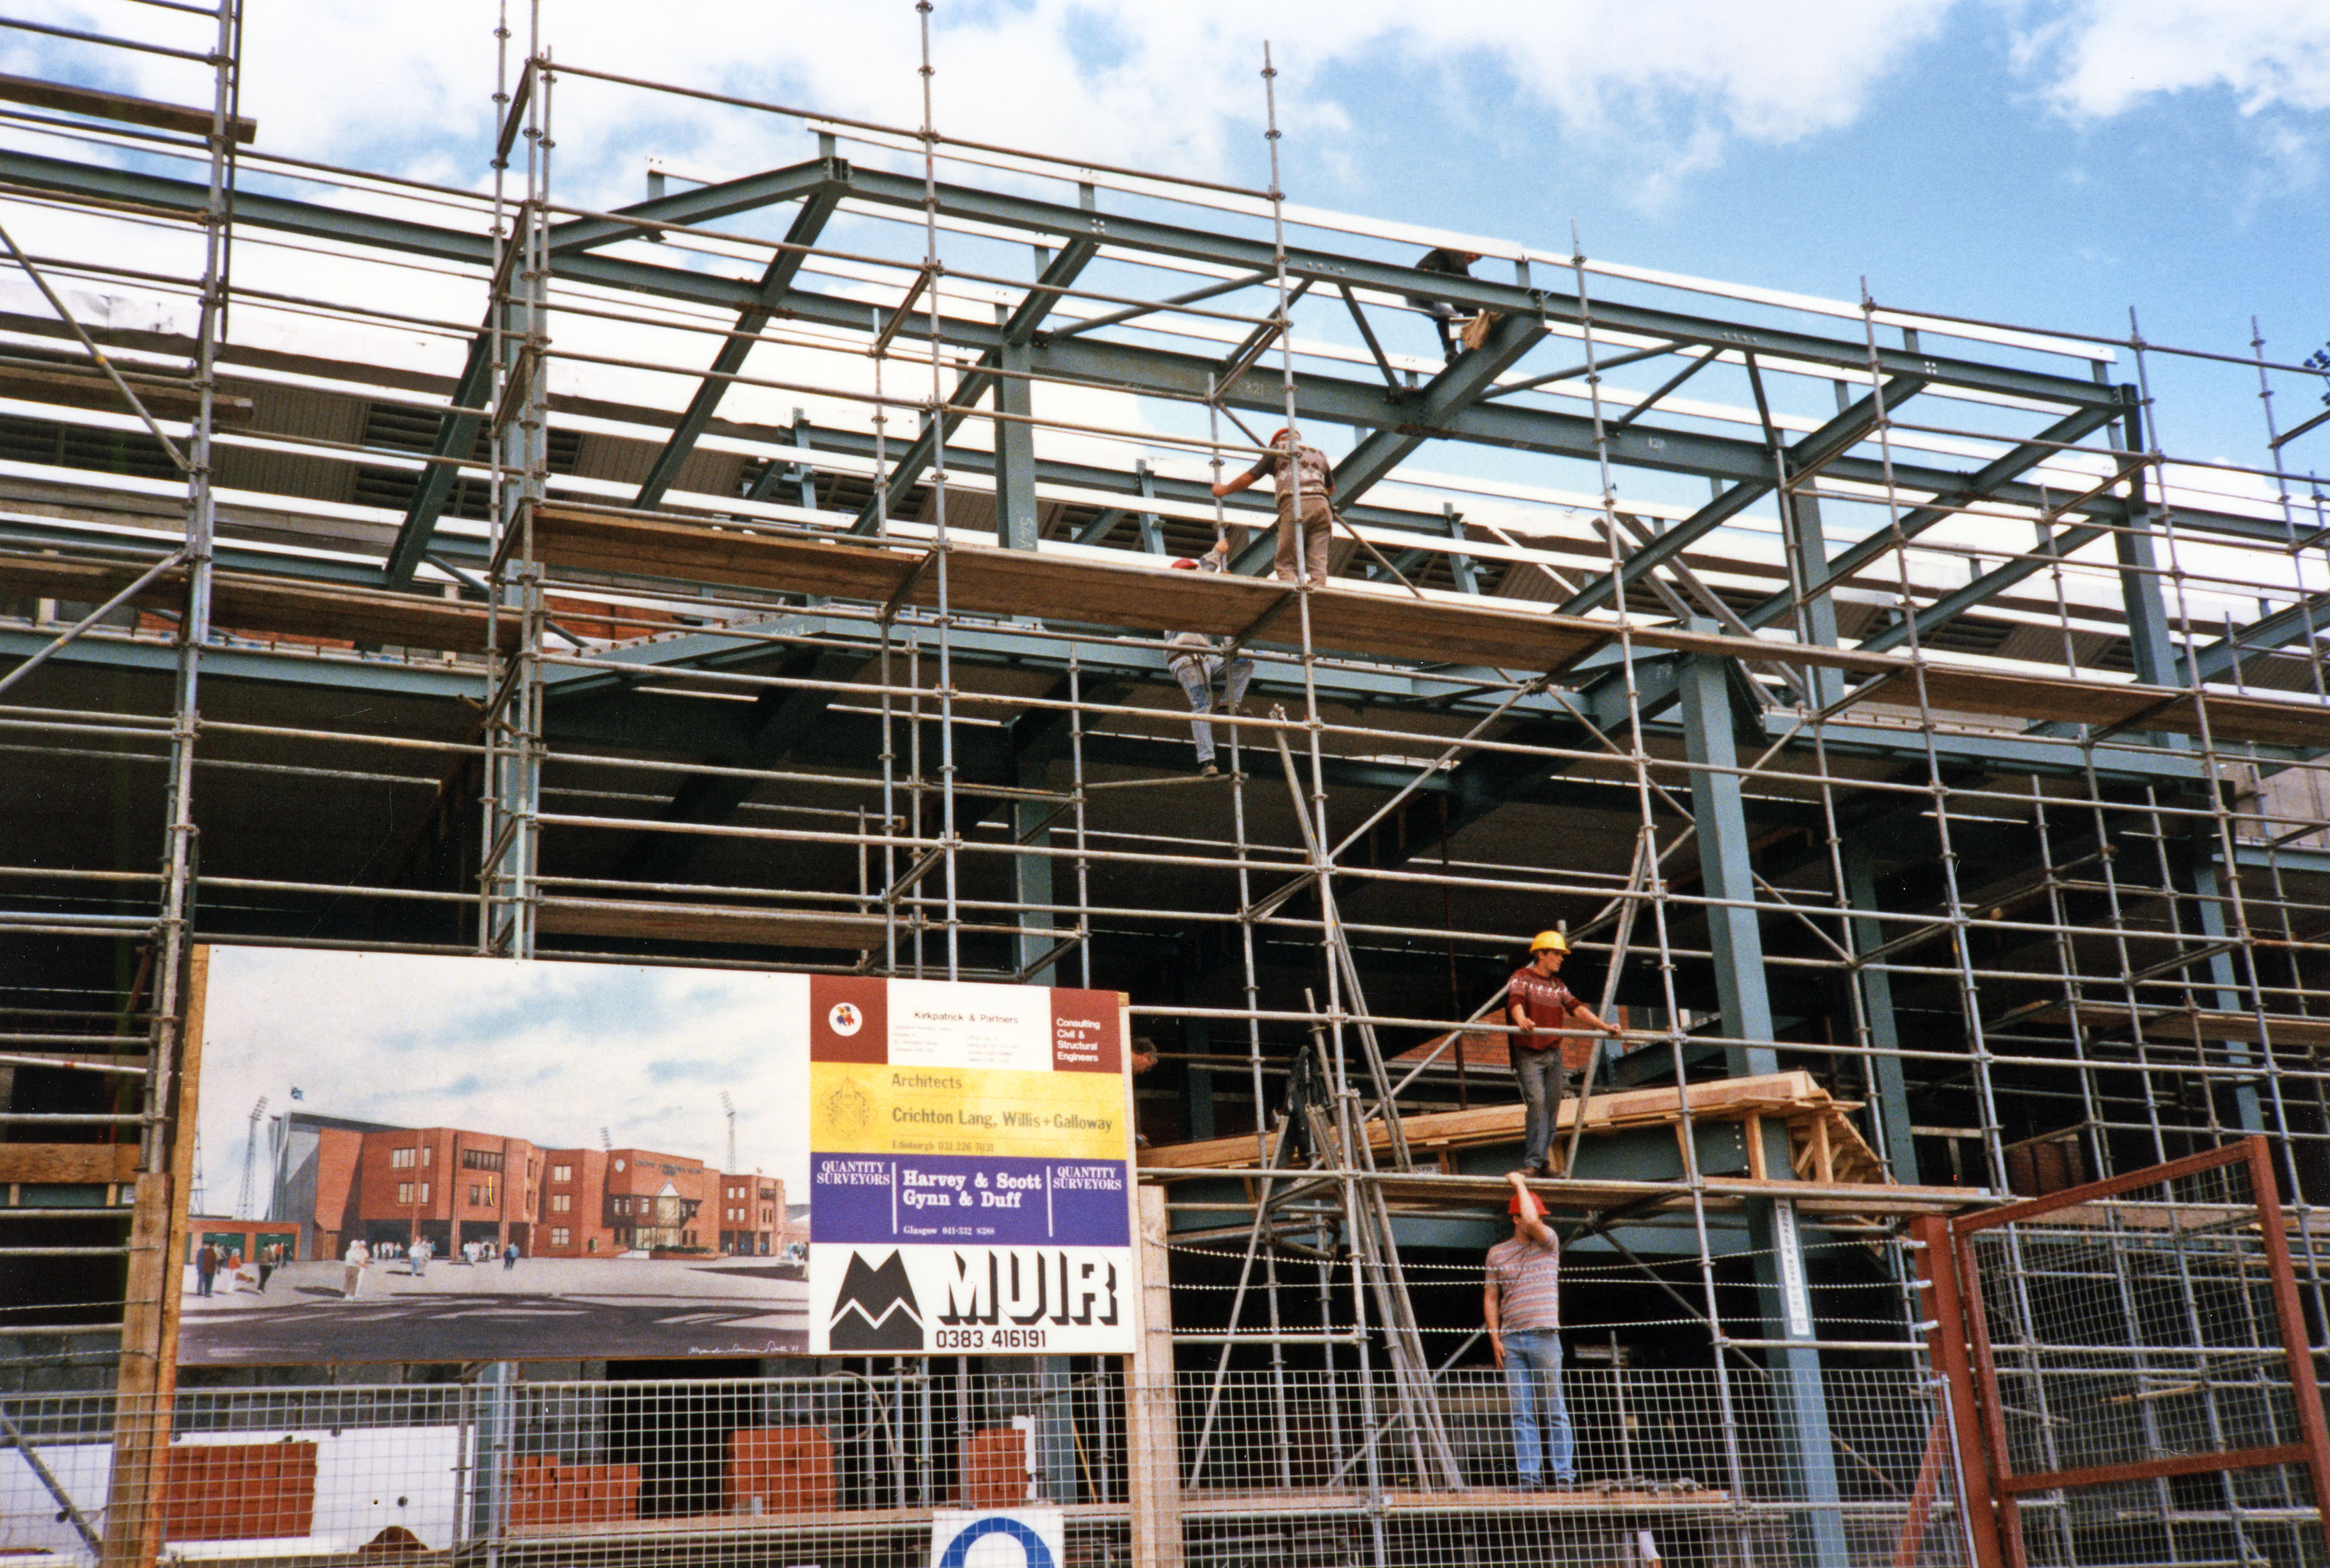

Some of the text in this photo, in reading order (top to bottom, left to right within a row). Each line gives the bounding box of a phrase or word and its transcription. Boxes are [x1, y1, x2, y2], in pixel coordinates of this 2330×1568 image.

[914, 1011, 1019, 1024] Kirkpatrick & Partners
[1056, 1018, 1101, 1030] Consulting
[1057, 1029, 1085, 1039] Civil &
[1057, 1040, 1098, 1050] Structural
[1057, 1052, 1099, 1062] Engineers
[892, 1073, 962, 1089] Architects
[892, 1107, 1112, 1133] Crichton Lang, Willis + Galloway
[892, 1140, 935, 1151] Edinburgh
[939, 1141, 953, 1151] 031
[957, 1142, 972, 1151] 226
[822, 1161, 884, 1173] QUANTITY
[1057, 1167, 1116, 1179] QUANTITY
[816, 1173, 890, 1185] SURVEYORS
[903, 1170, 1042, 1191] Harvey & Scott
[1053, 1178, 1122, 1190] SURVEYORS
[903, 1189, 1022, 1209] Gynn & Duff
[903, 1225, 937, 1235] Glasgow
[937, 1249, 1118, 1326] MUIR
[936, 1330, 1046, 1348] 0383 416191
